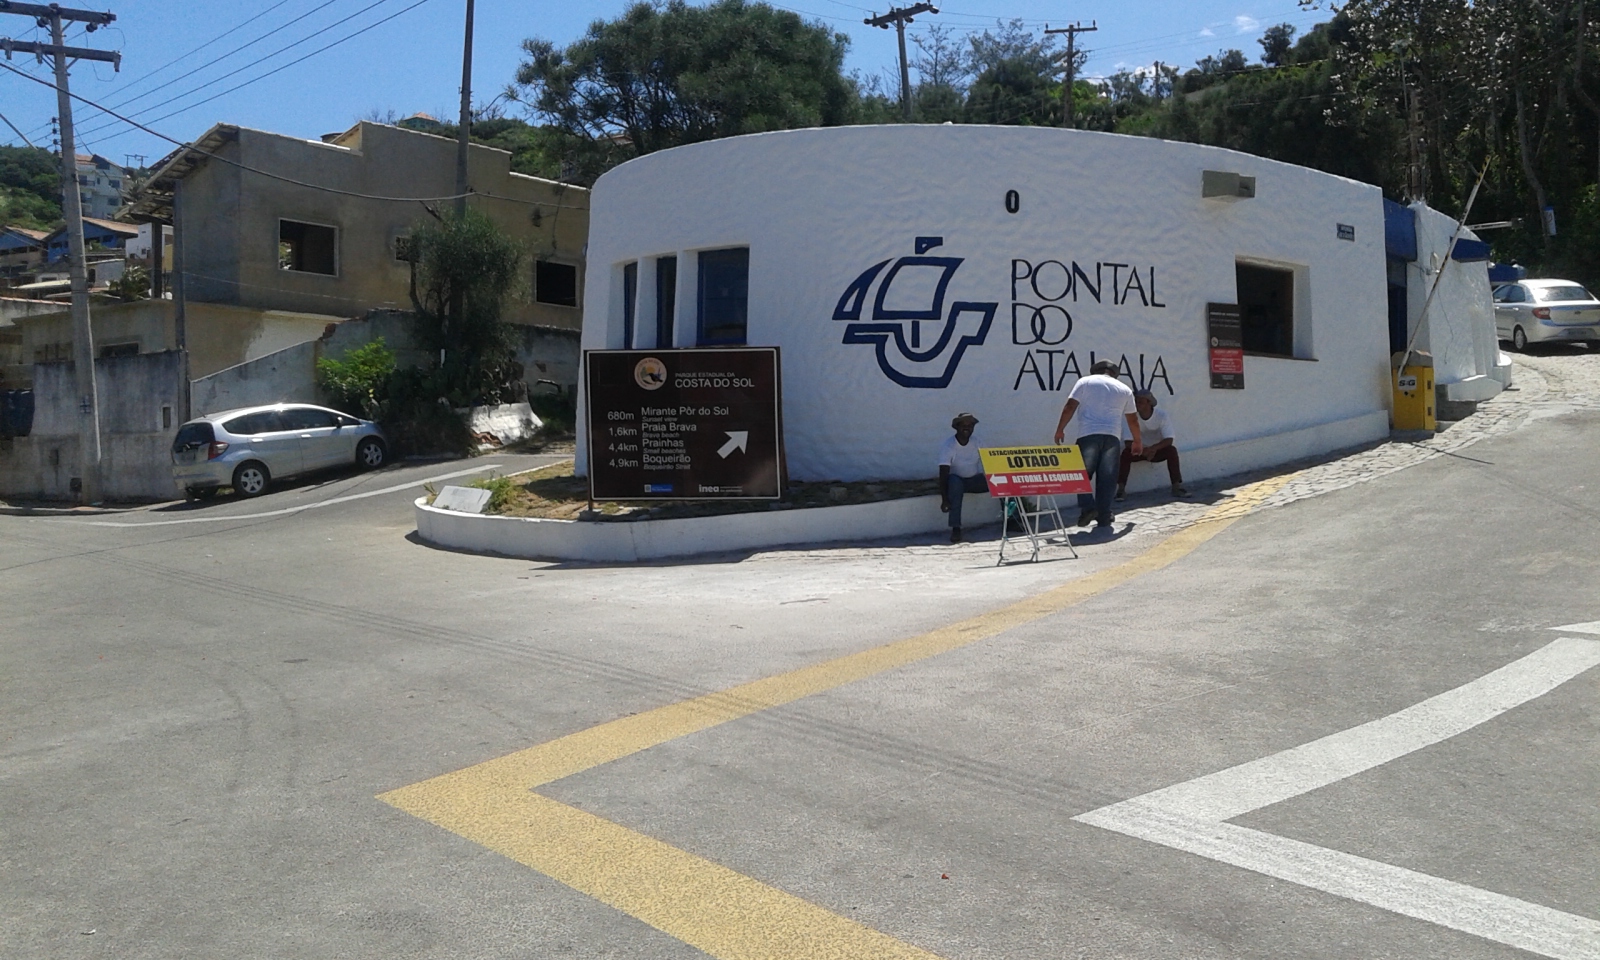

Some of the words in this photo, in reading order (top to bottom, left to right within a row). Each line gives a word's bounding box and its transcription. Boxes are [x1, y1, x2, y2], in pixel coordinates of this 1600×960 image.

[1011, 259, 1166, 308] PONTAL
[1011, 302, 1073, 345] DO
[674, 378, 712, 388] COSTA
[713, 378, 730, 388] DO
[732, 377, 755, 388] SOL
[607, 411, 635, 421] 680m
[641, 406, 677, 416] Mirante
[679, 406, 696, 416] Pôr
[698, 406, 711, 416] do
[713, 406, 729, 416] Sol
[641, 422, 667, 431] Praia
[669, 422, 697, 431] Brava
[609, 427, 637, 437] 1,6km
[608, 443, 638, 452] 4,4km
[642, 439, 684, 447] Prainhas
[988, 448, 1043, 456] ESTACIONAMENTO
[609, 459, 639, 468] 4,9km
[642, 454, 691, 464] Boqueirão
[1006, 454, 1060, 468] LOTADO
[1011, 474, 1043, 484] RETORNE
[1042, 472, 1049, 482] À
[1048, 472, 1085, 483] ESQUERDA
[698, 484, 720, 493] inea
